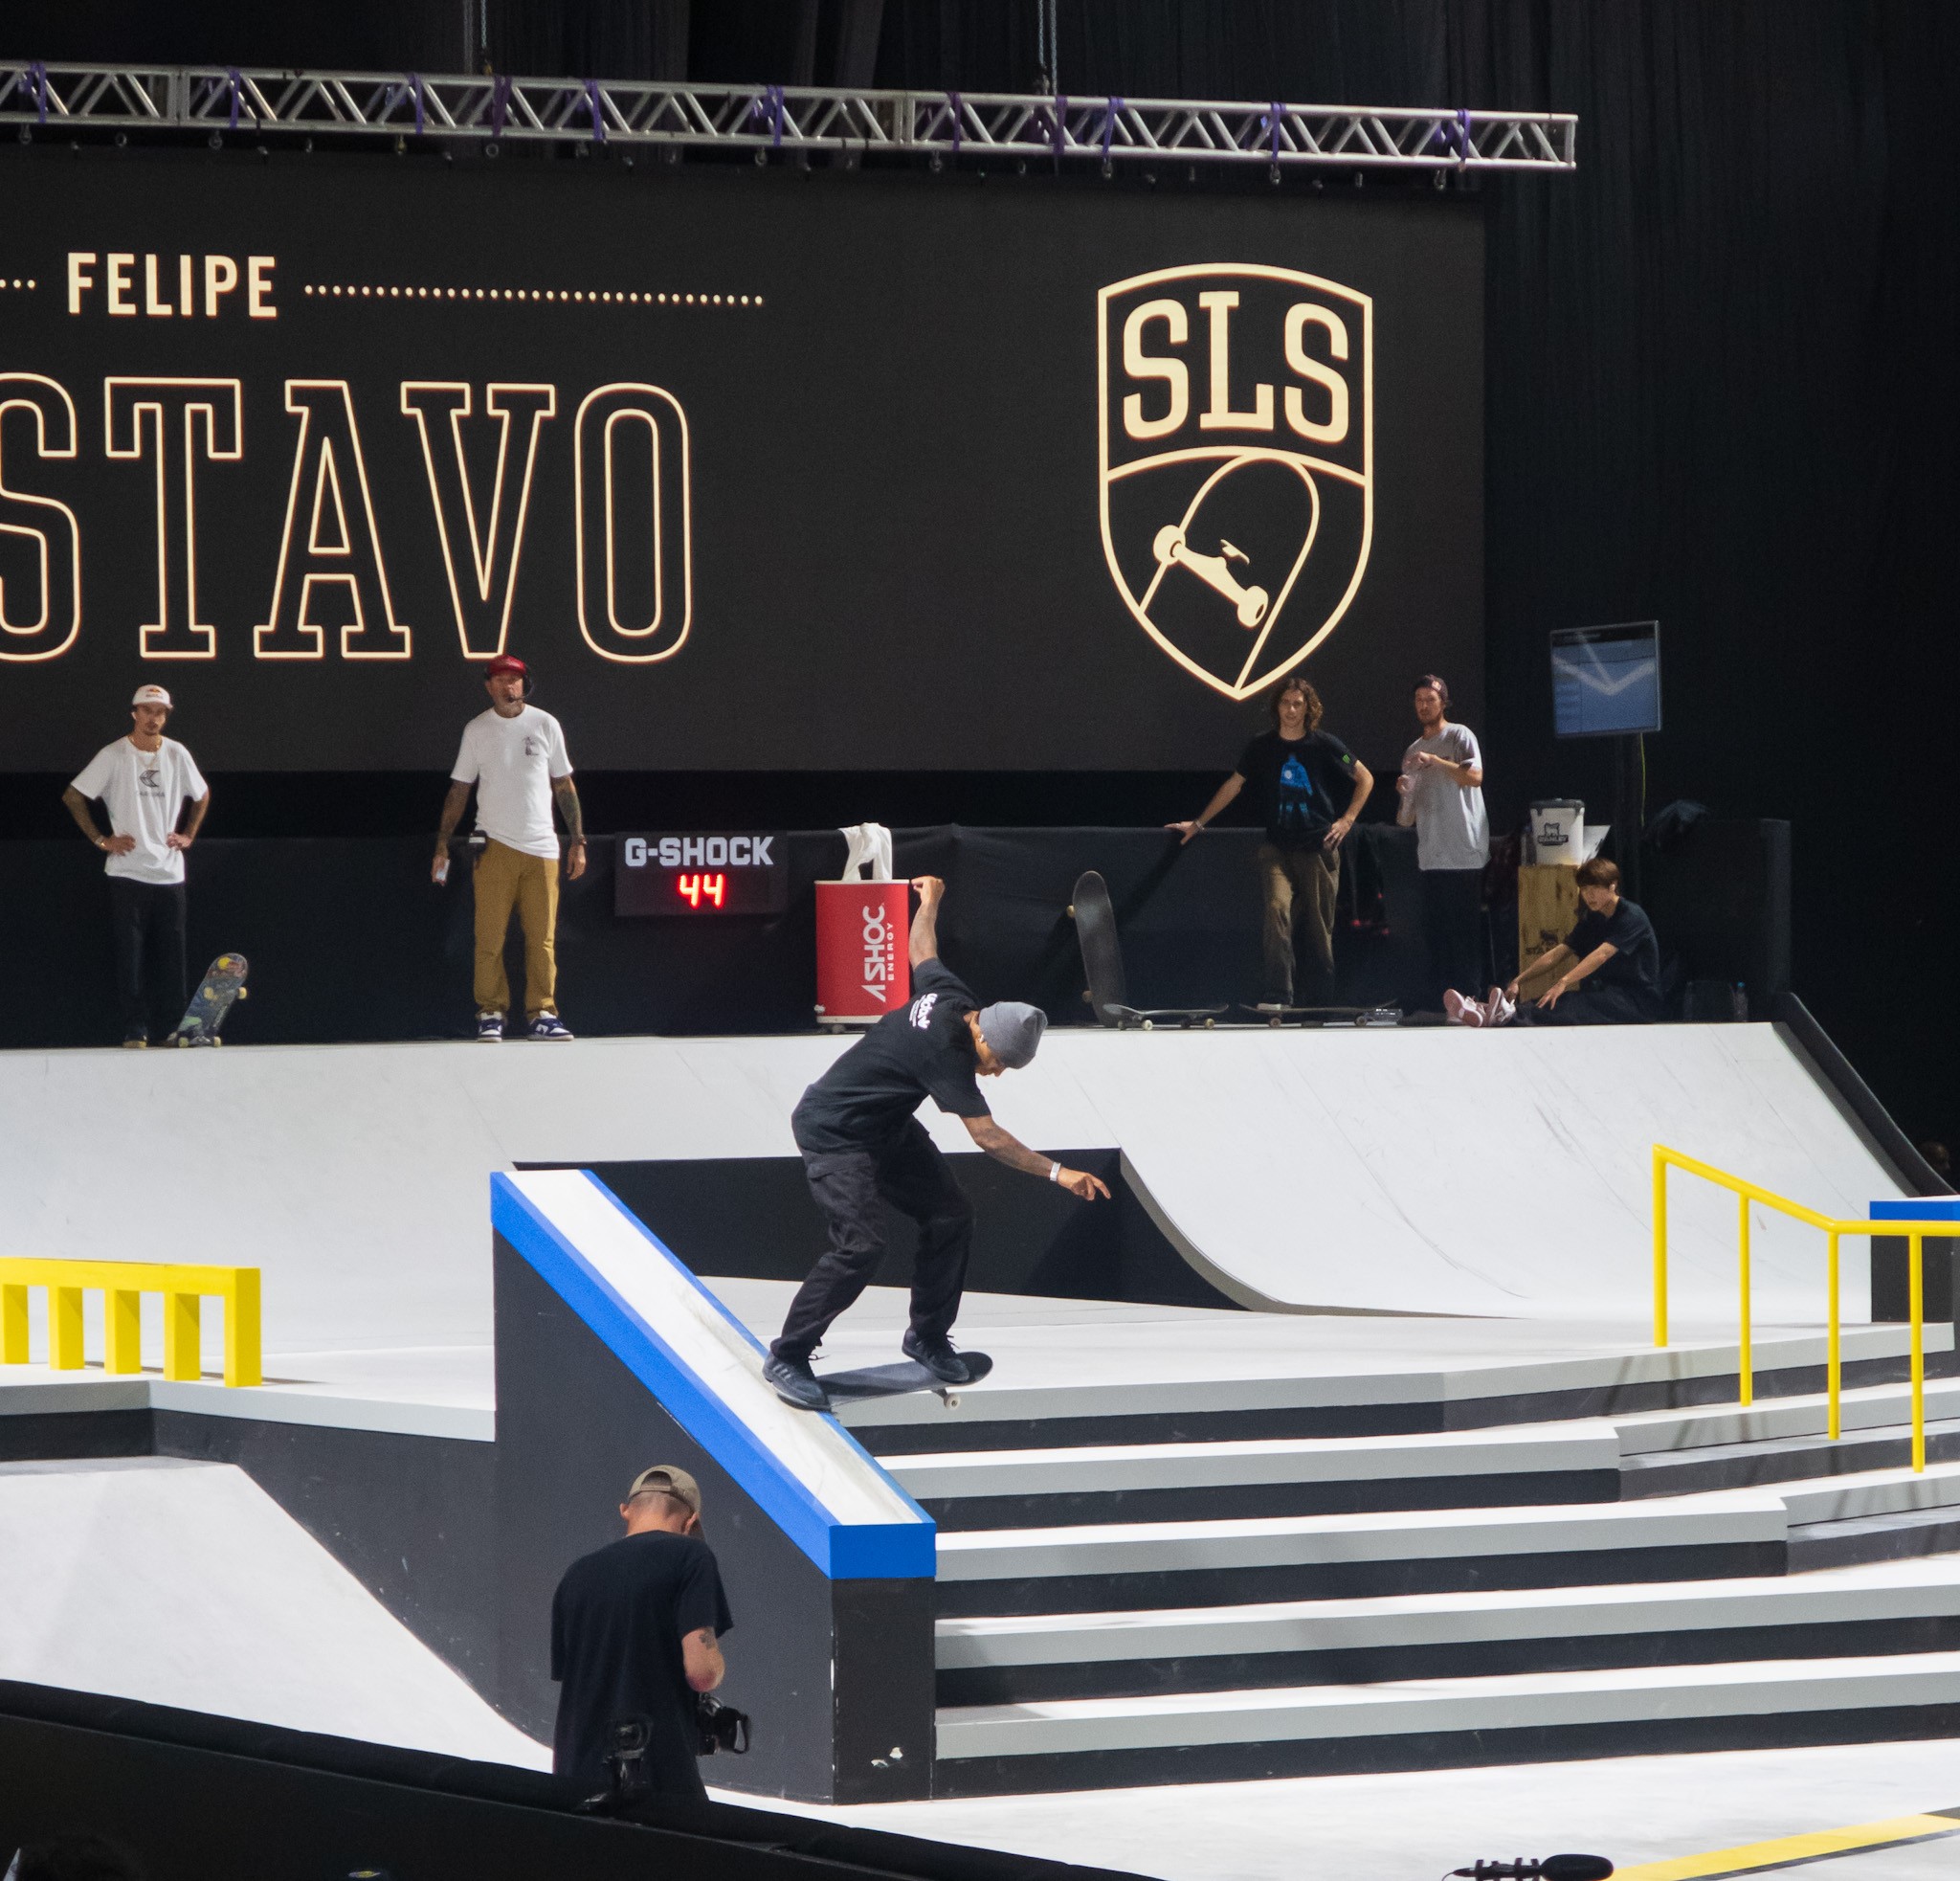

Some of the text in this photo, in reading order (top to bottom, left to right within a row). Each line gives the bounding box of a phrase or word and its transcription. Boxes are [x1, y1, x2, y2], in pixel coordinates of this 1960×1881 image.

[67, 252, 278, 318] FELIPE
[1123, 290, 1349, 444] SLS
[625, 836, 774, 867] G-SHOCK
[678, 873, 726, 909] 44
[860, 904, 886, 1003] ASHOC
[886, 922, 895, 981] ENERGY
